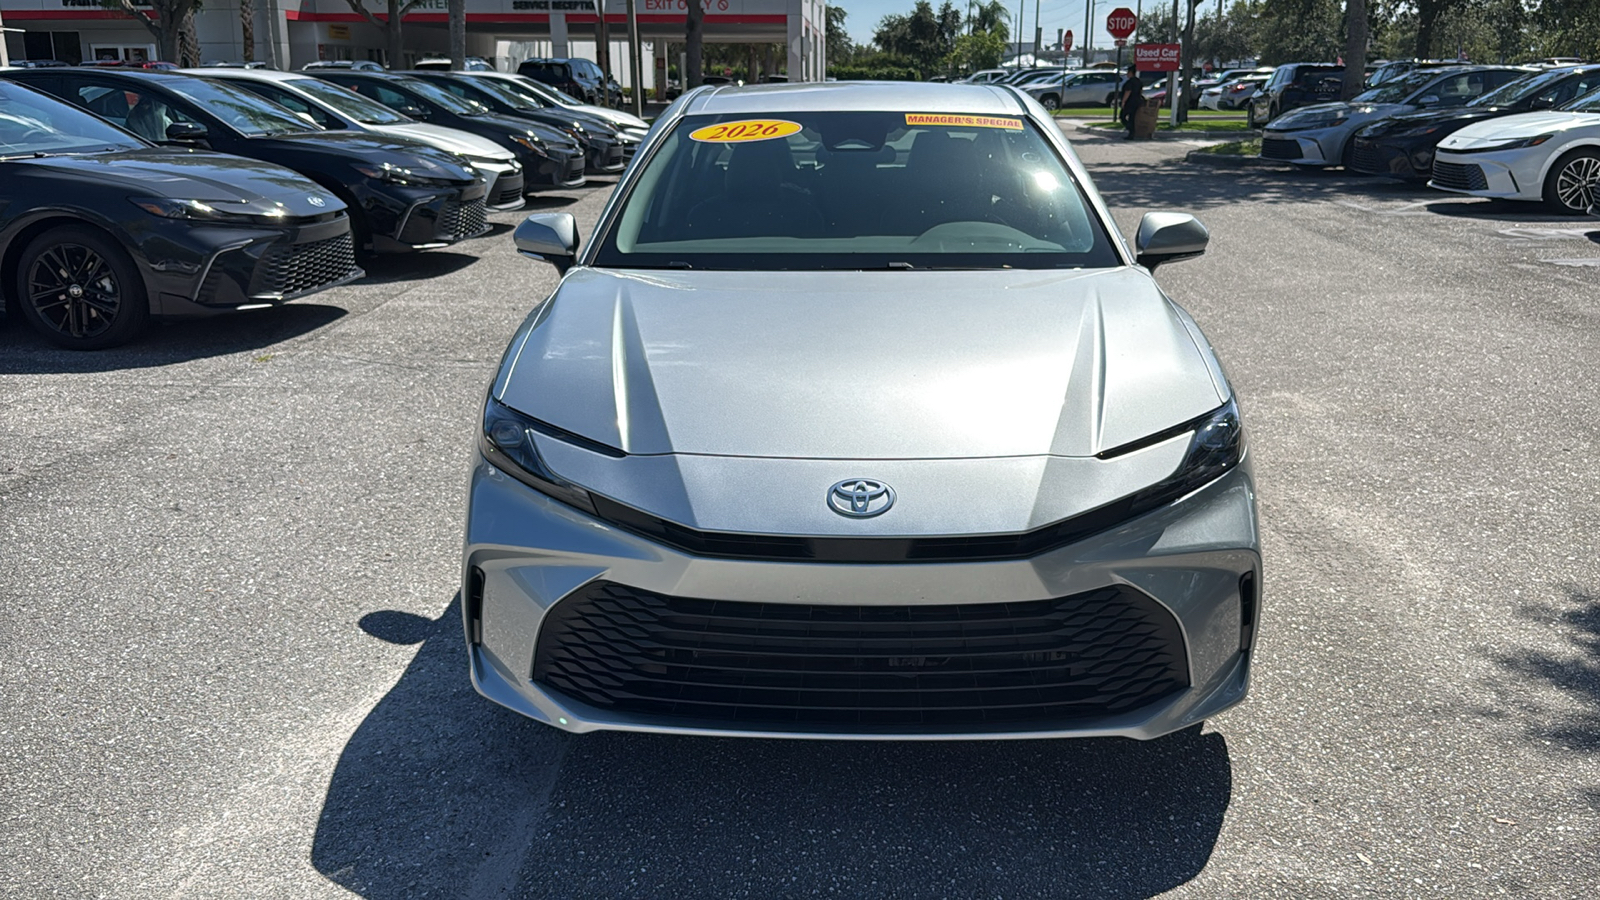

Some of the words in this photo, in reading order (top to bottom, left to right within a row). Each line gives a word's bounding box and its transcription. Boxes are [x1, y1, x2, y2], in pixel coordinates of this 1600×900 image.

[513, 1, 550, 10] SERVICE
[552, 1, 597, 10] RECEPTIO
[646, 0, 672, 10] EXIT
[677, 0, 712, 10] OY
[1108, 17, 1135, 30] STOP
[1136, 48, 1160, 57] Used
[1162, 48, 1179, 57] Car
[907, 115, 974, 125] MANAGER'S
[976, 117, 1021, 128] SPECIAL
[707, 122, 784, 140] 2026
